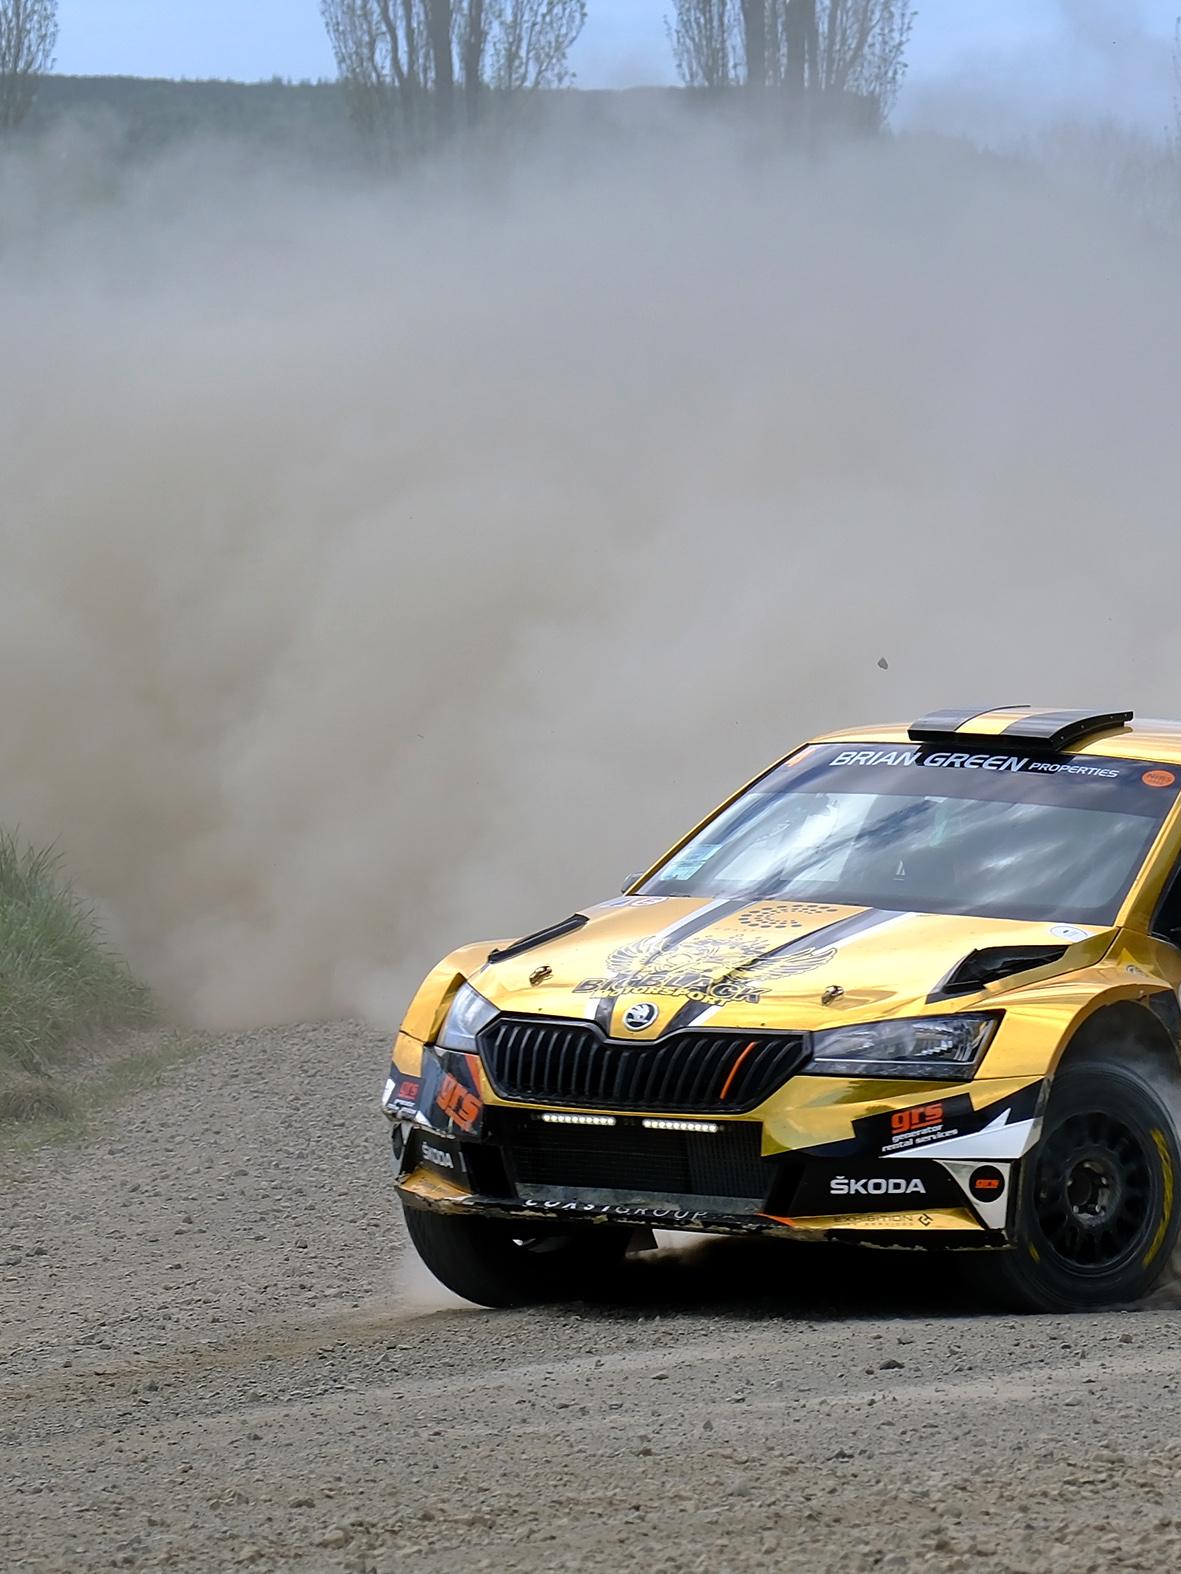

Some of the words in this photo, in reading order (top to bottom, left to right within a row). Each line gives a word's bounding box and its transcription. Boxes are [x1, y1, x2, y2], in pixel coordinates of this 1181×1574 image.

[828, 751, 922, 767] BRIAN
[922, 752, 1030, 772] GREEN
[1029, 762, 1120, 778] PROPERTIES
[436, 1072, 483, 1134] grs
[891, 1103, 944, 1134] grs
[881, 1138, 914, 1152] rental
[915, 1129, 959, 1144] services
[892, 1124, 944, 1143] generator
[830, 1175, 928, 1194] ŠKODA
